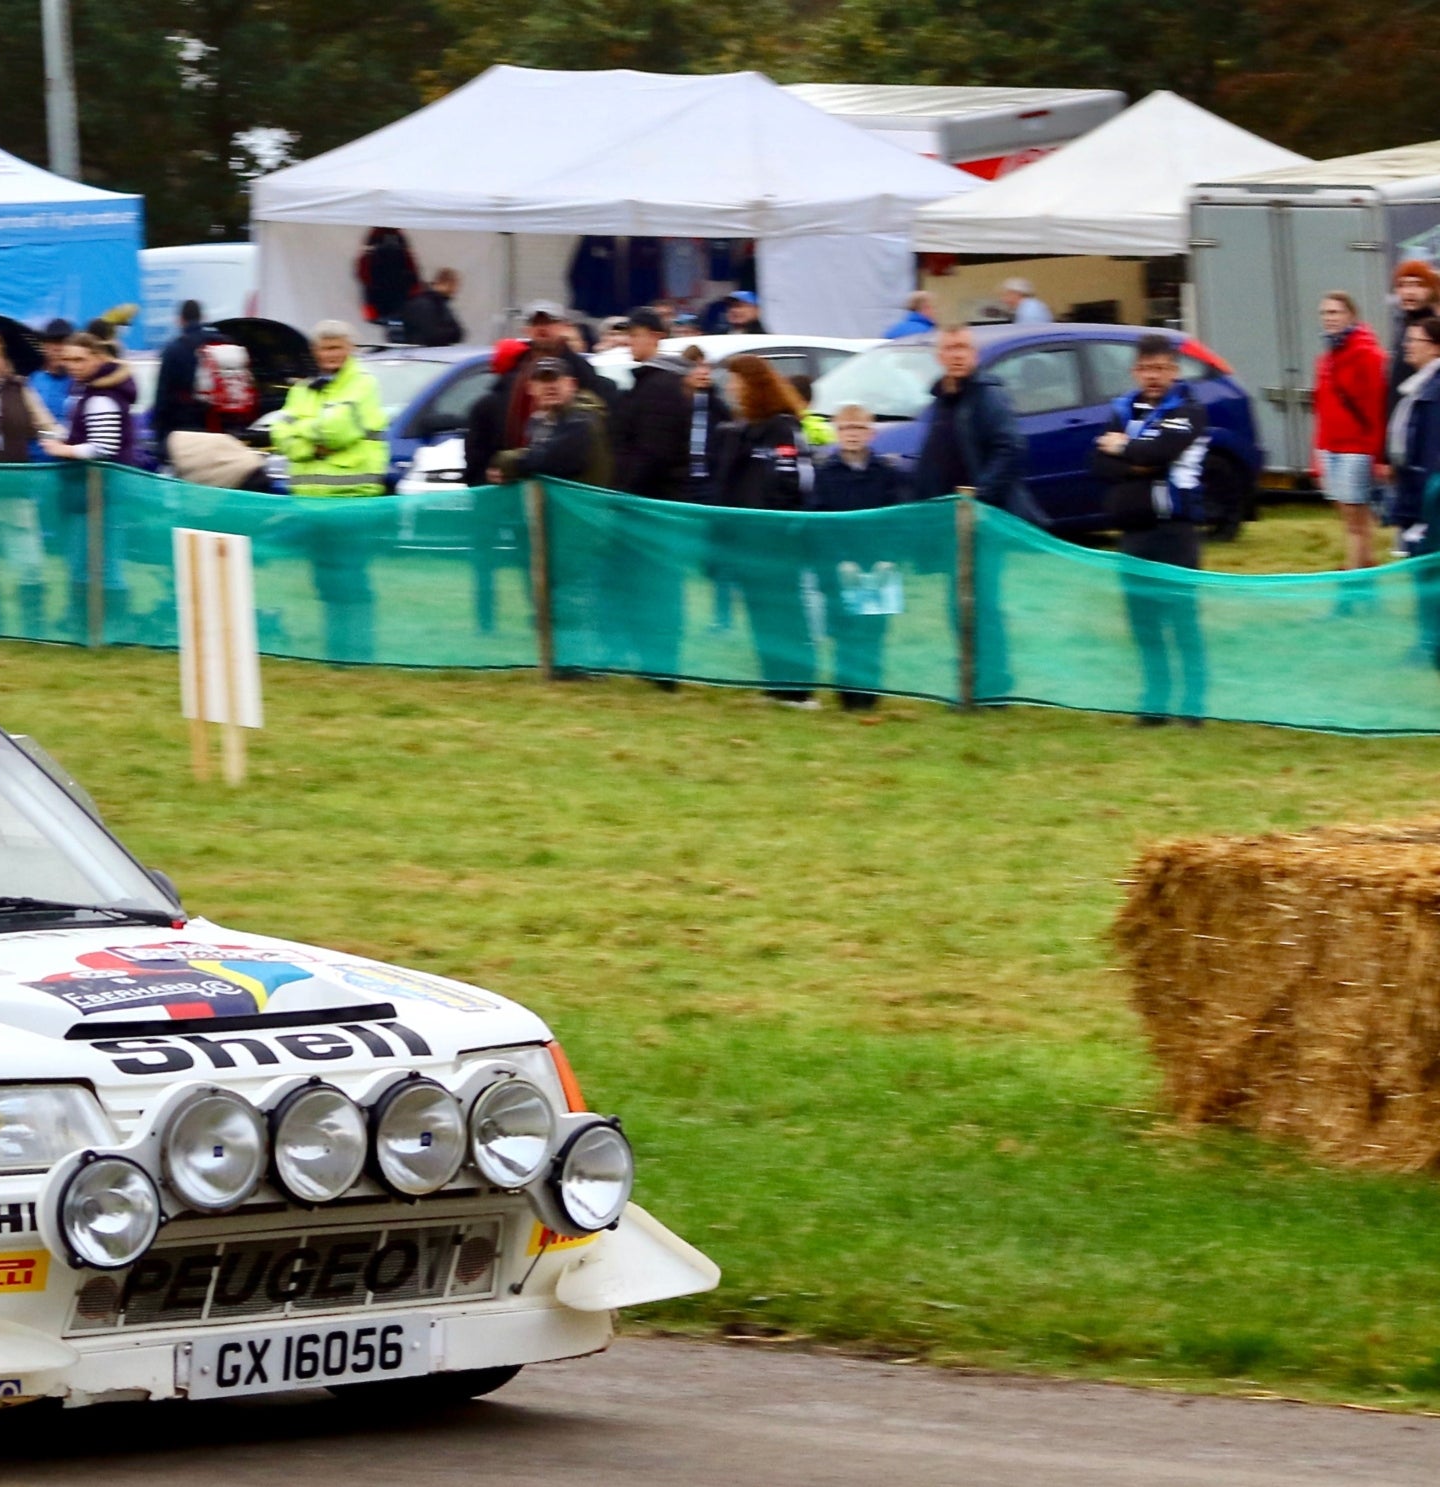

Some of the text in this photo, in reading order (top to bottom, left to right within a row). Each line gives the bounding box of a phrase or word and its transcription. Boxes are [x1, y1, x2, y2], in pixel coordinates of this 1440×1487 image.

[62, 982, 198, 1004] EBERHARD
[90, 1021, 433, 1075] Shell
[113, 1234, 463, 1312] PEUGEOT
[215, 1324, 404, 1389] GX 16056
